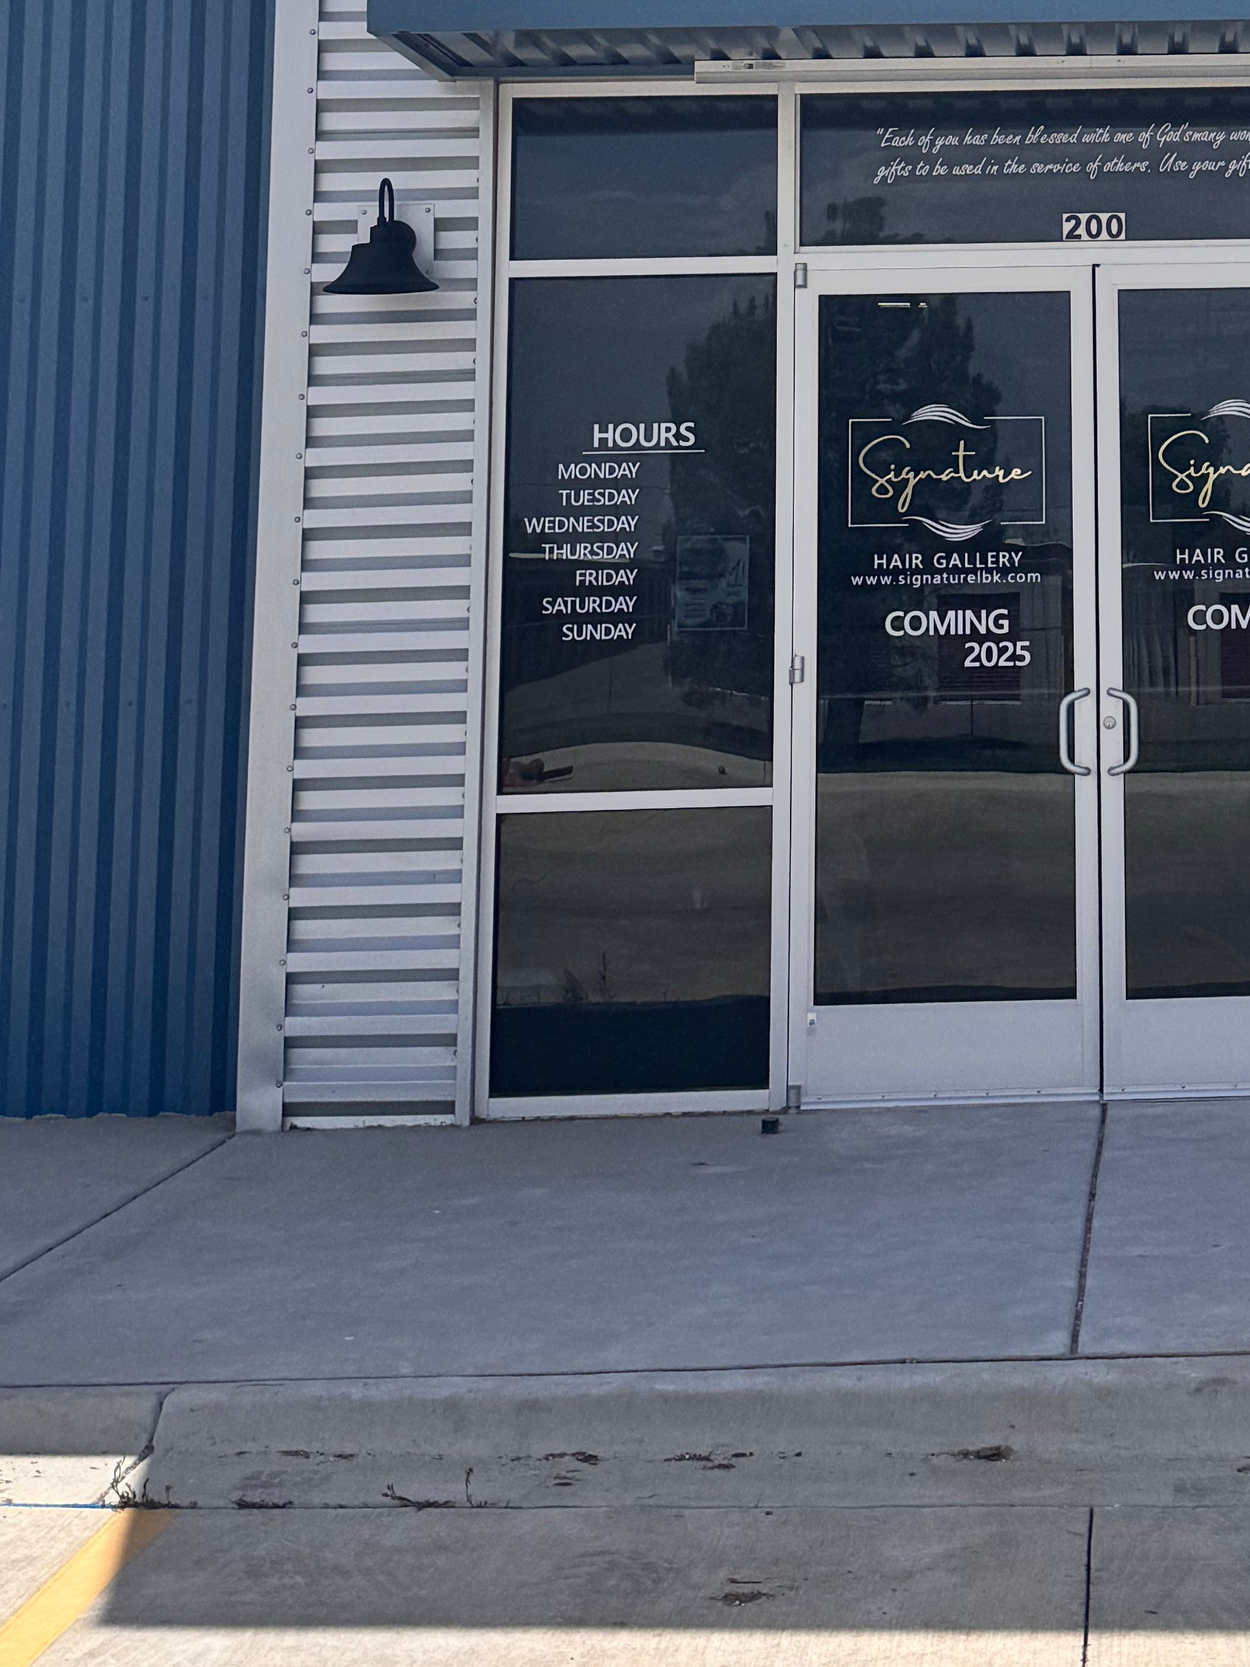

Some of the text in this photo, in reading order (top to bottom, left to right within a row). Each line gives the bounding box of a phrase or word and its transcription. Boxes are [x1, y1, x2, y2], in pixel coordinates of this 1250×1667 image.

[917, 127, 935, 154] of
[932, 135, 959, 154] you
[963, 128, 986, 146] has
[990, 127, 1022, 145] been
[1024, 126, 1082, 145] blessed
[1081, 125, 1110, 143] with
[1113, 132, 1134, 142] one
[1138, 123, 1156, 149] of
[873, 158, 912, 184] gifts
[915, 160, 929, 176] to
[932, 158, 949, 176] be
[952, 157, 988, 176] used
[985, 160, 999, 175] in
[1003, 156, 1027, 175] the
[1029, 158, 1081, 175] service
[1085, 154, 1103, 180] of
[1103, 152, 1151, 173] others.
[1159, 152, 1189, 173] Use
[1188, 160, 1226, 179] your
[1064, 214, 1124, 240] 200
[592, 422, 696, 448] HOURS
[558, 462, 640, 479] MONDAY
[858, 435, 1032, 513] Signature
[558, 489, 640, 506] TUESDAY
[524, 515, 639, 534] WEDNESDAY
[541, 542, 639, 561] THURSDAY
[873, 551, 1024, 570] HAIR GALLERY
[1176, 548, 1226, 565] HAIR
[575, 569, 638, 586] FRIDAY
[851, 570, 1042, 588] www.signaturelbk.com
[541, 596, 637, 614] SATURDAY
[561, 623, 637, 641] SUNDAY
[884, 609, 1010, 637] COMING
[963, 641, 1032, 668] 2025
